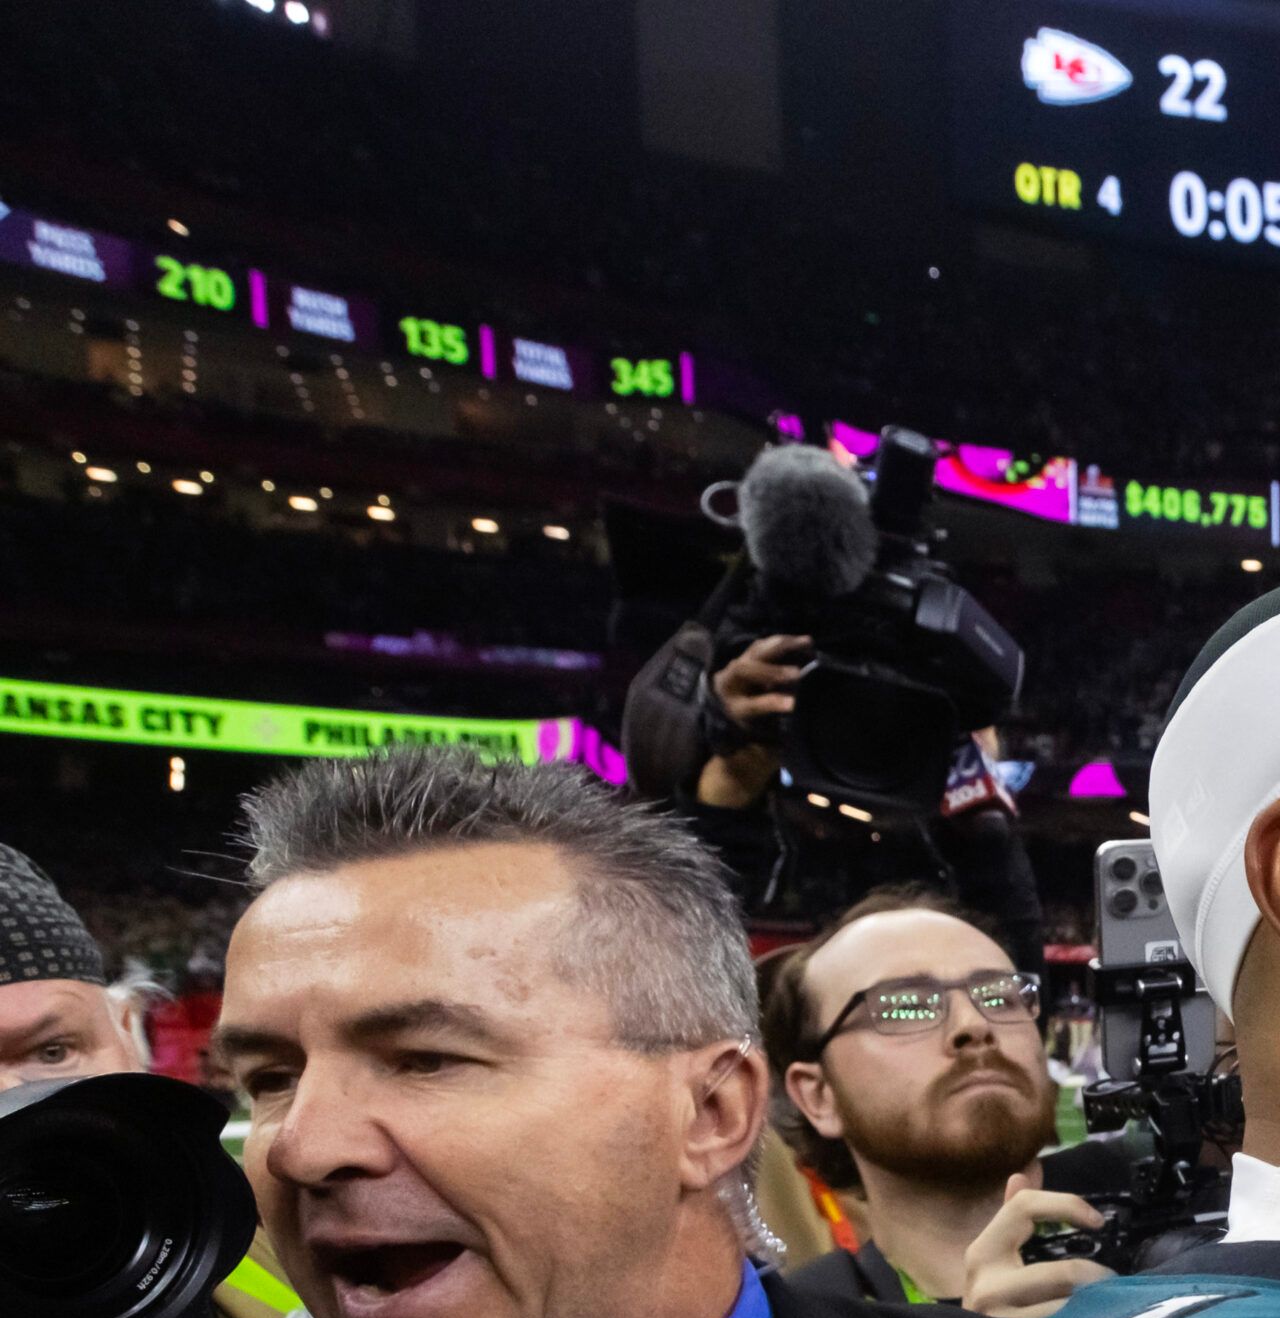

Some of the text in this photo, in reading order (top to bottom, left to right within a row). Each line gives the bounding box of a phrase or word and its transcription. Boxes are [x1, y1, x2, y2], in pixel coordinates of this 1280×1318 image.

[1158, 54, 1228, 122] 22
[1096, 174, 1122, 216] 4
[154, 255, 235, 311] 210
[399, 316, 469, 365] 135
[610, 357, 674, 397] 345
[140, 706, 223, 738] CITY
